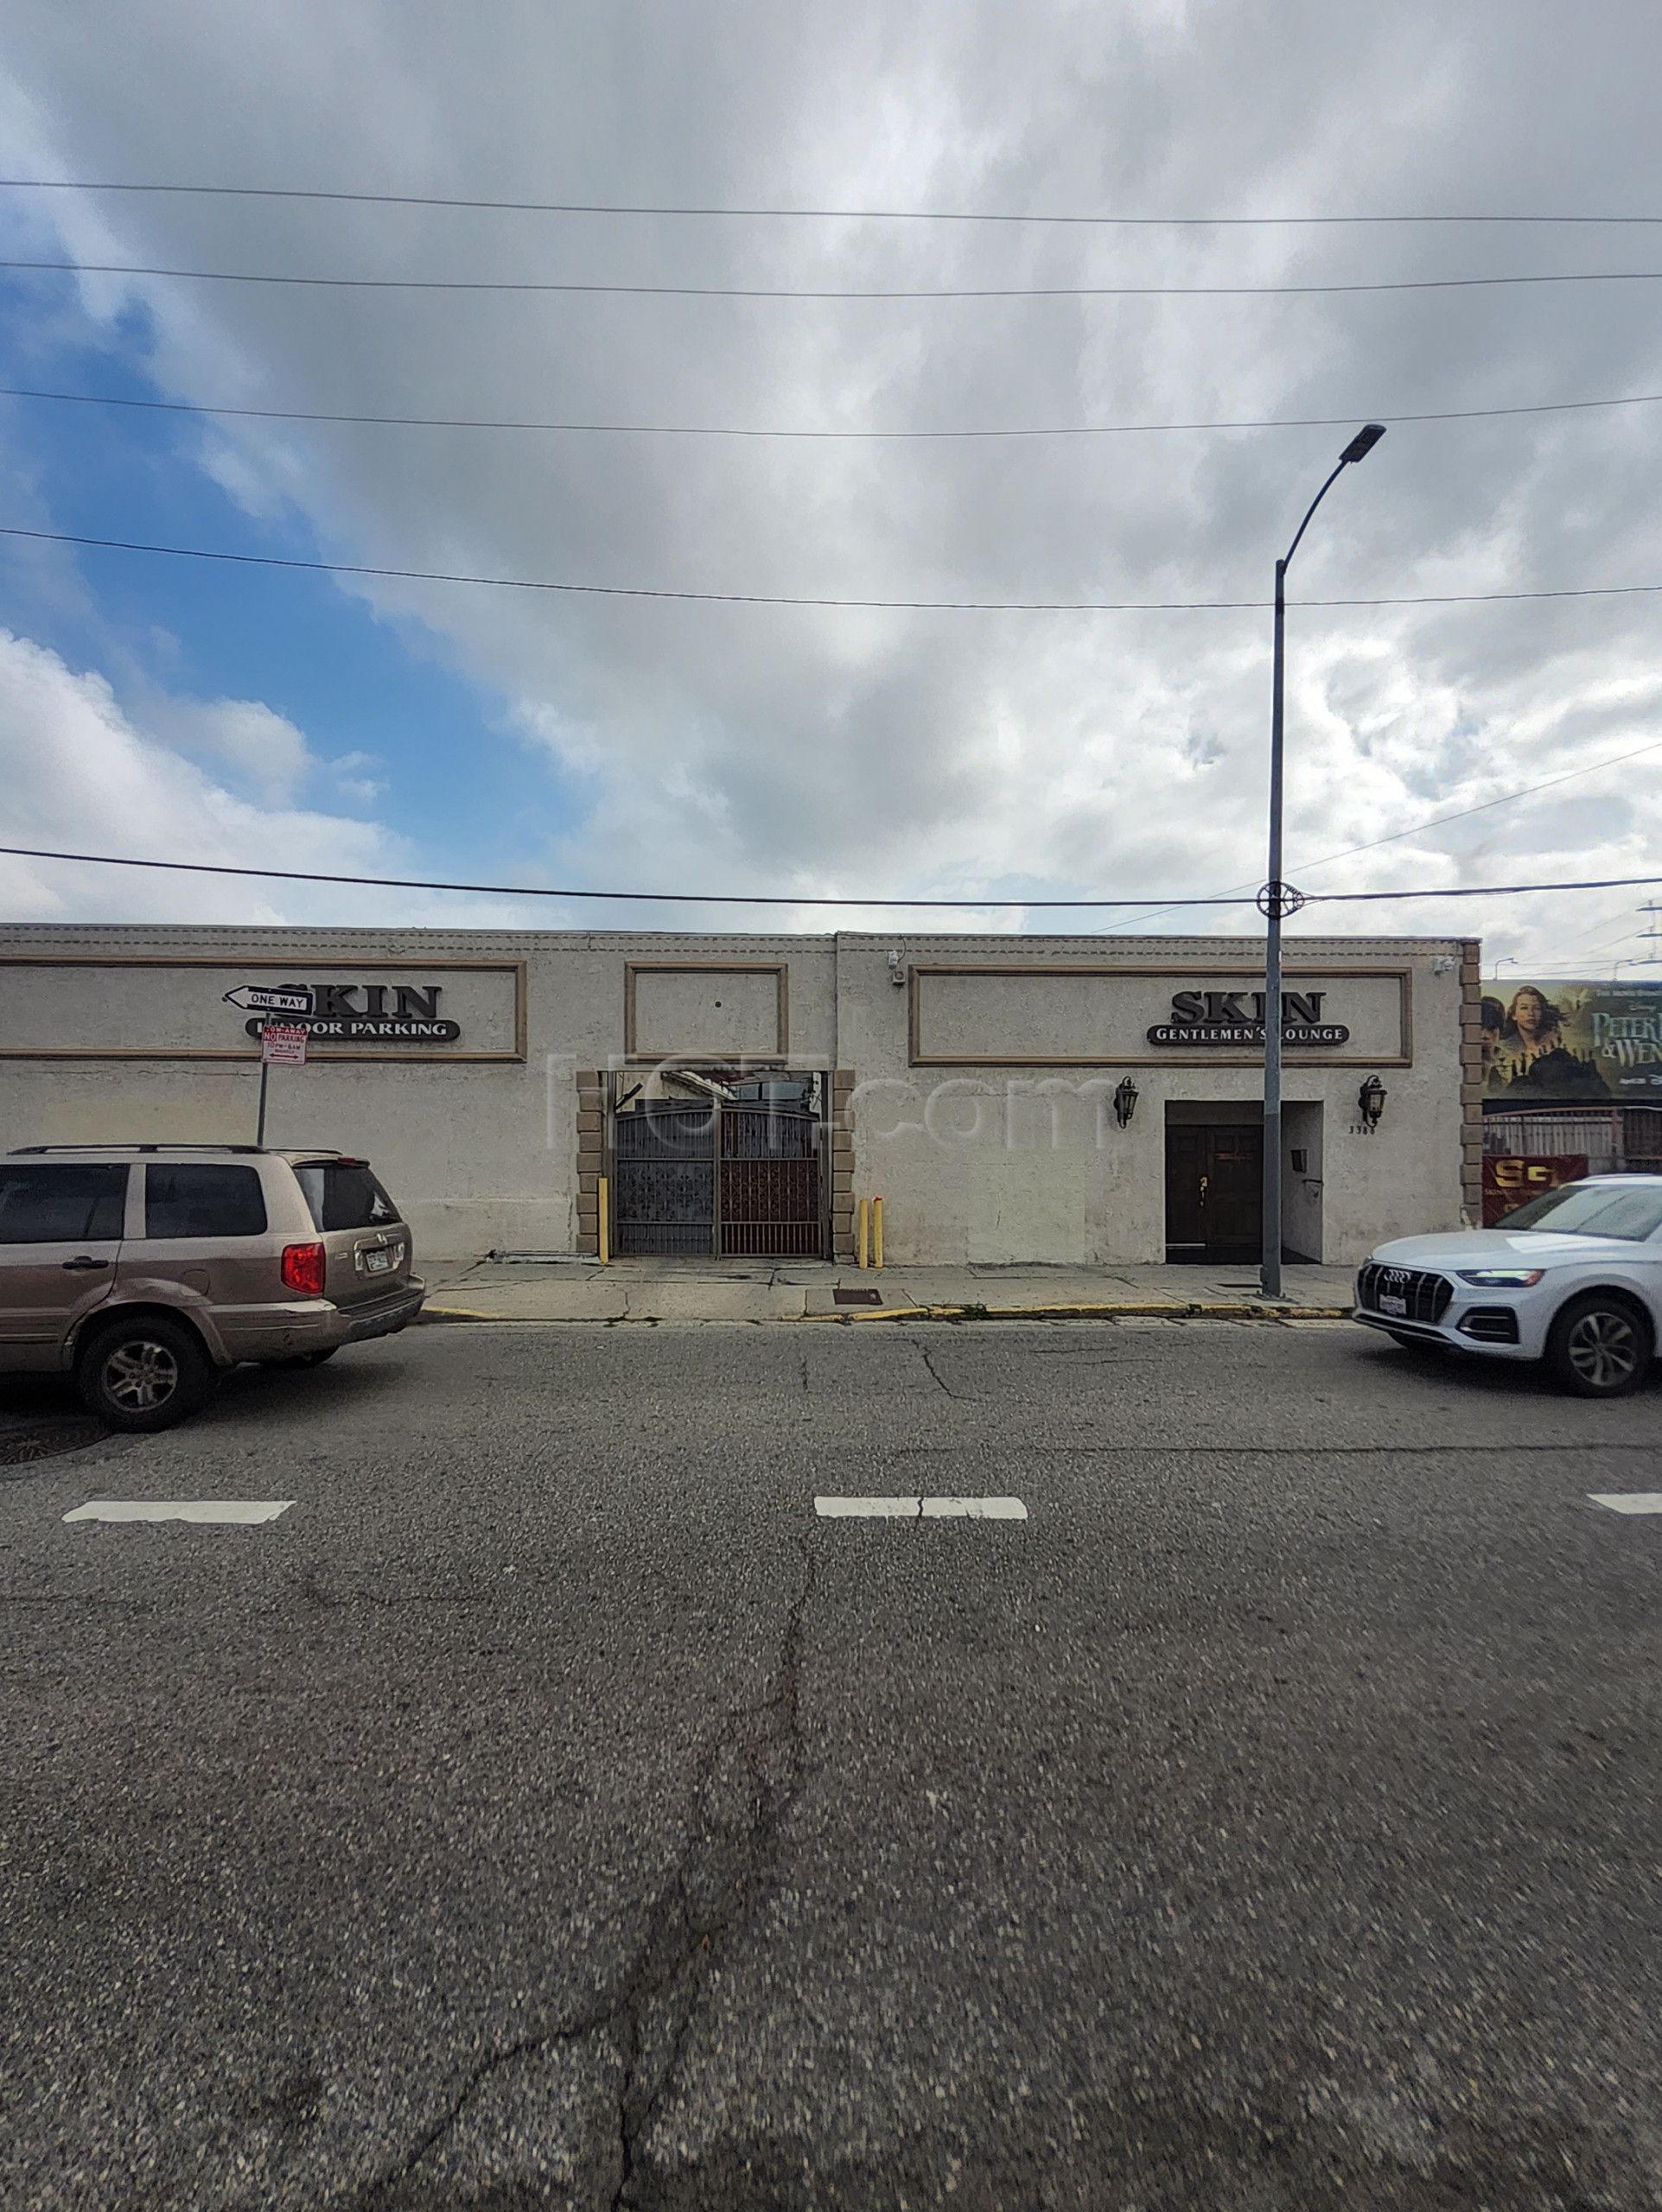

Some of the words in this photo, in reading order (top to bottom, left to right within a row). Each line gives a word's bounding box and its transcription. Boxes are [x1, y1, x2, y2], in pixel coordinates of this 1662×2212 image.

[252, 994, 275, 1005] ONE
[280, 997, 304, 1008] WAY
[275, 983, 443, 1018] KIN
[1170, 991, 1327, 1024] SKIN
[257, 1021, 344, 1034] IOOR
[351, 1022, 447, 1035] PARKING
[1156, 1027, 1266, 1039] GENTLEMEN'S
[1280, 1028, 1343, 1040] OUNGE
[264, 1032, 277, 1041] NO
